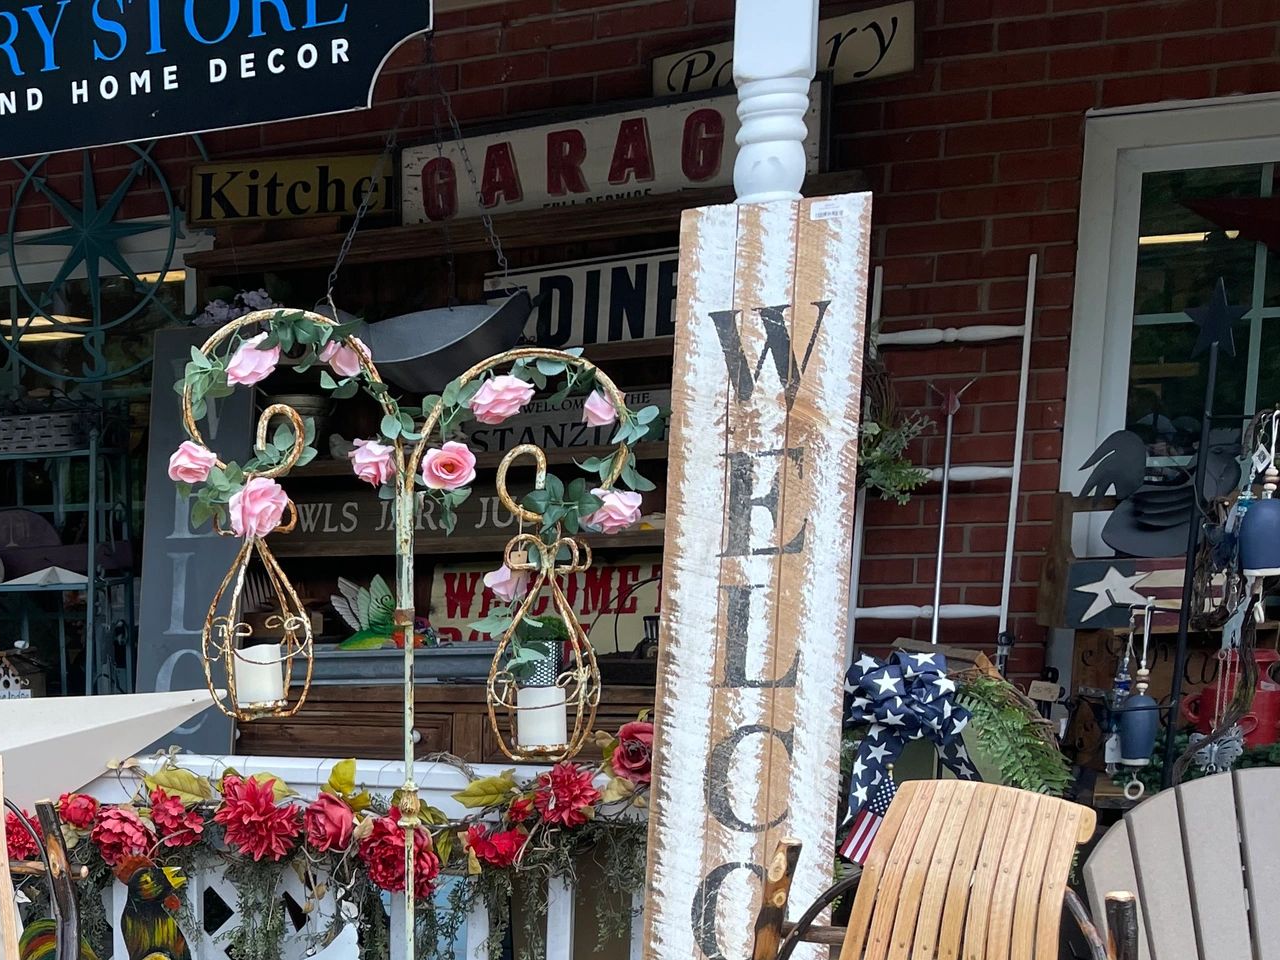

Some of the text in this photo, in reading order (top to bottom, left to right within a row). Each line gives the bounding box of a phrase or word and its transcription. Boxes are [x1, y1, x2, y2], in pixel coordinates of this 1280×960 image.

[71, 65, 179, 104] HOME
[209, 38, 350, 84] DECOR
[421, 107, 726, 221] GARAG
[537, 258, 680, 349] DINE
[523, 398, 584, 415] WELOM
[471, 420, 624, 451] STANZI
[297, 502, 359, 533] WLS
[374, 498, 458, 533] JRS
[443, 564, 639, 619] WECOME
